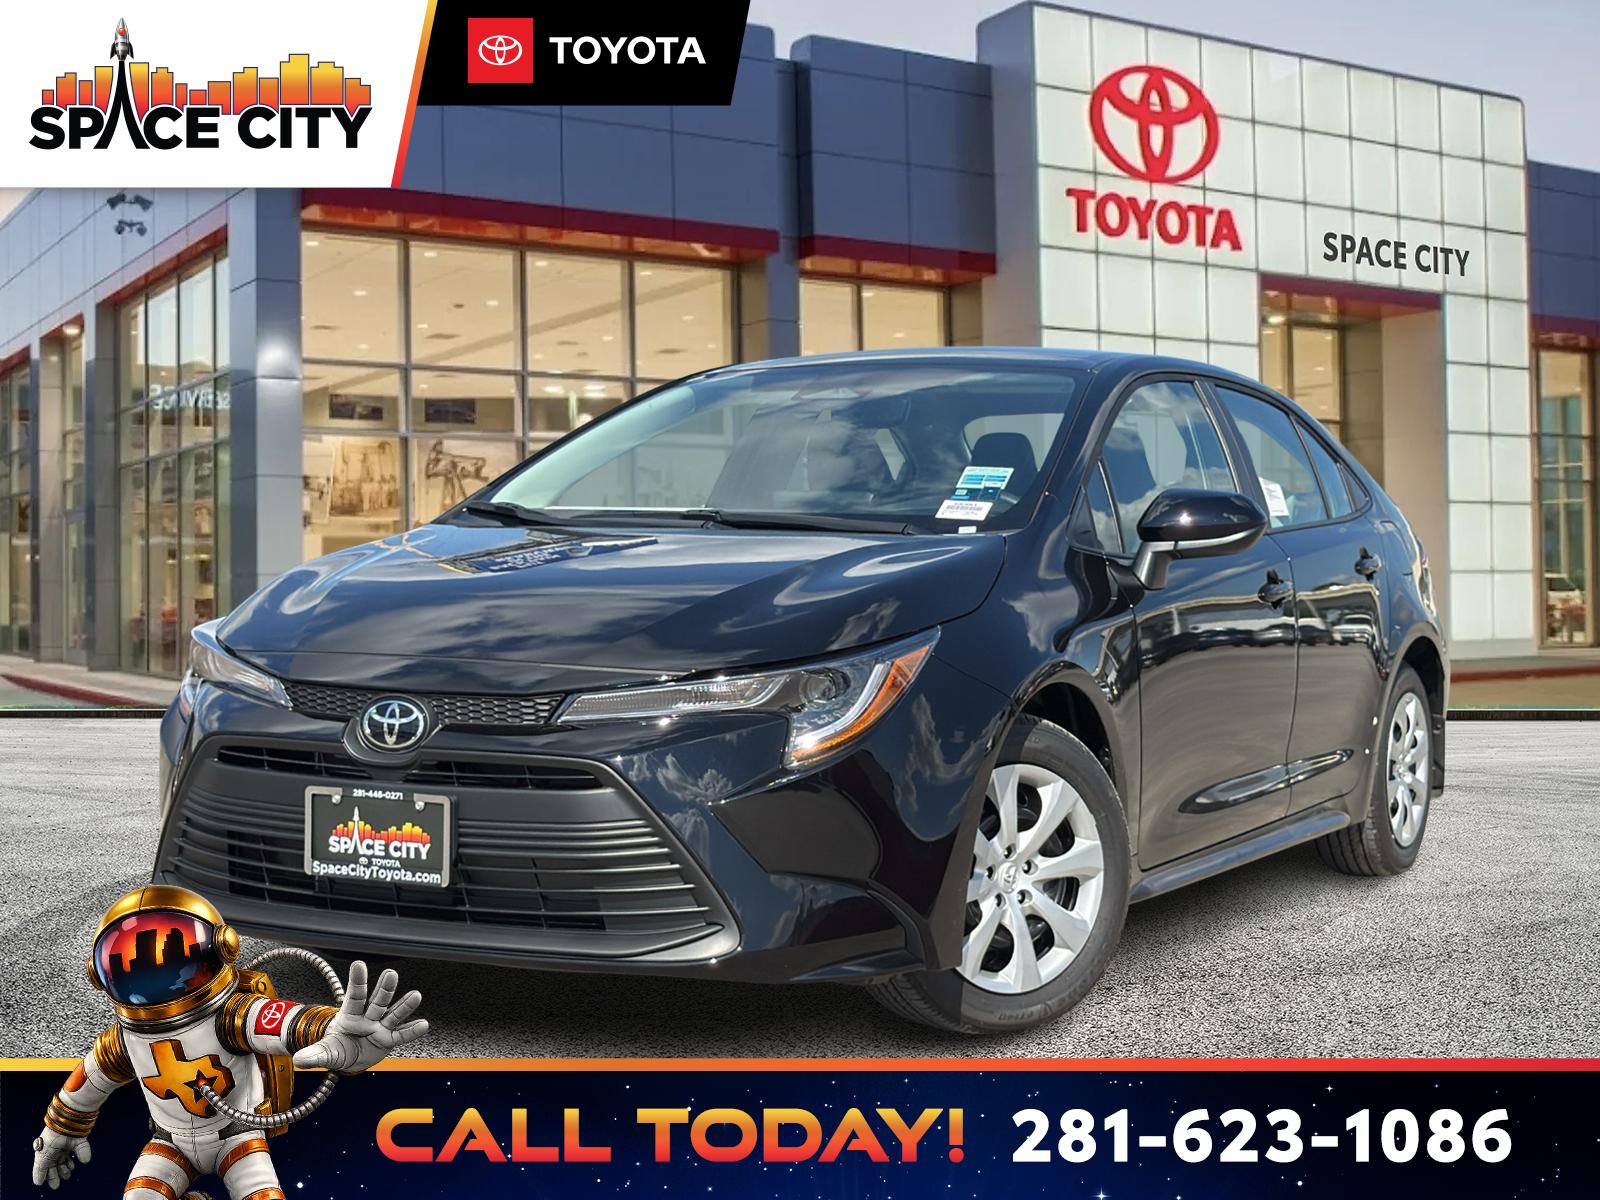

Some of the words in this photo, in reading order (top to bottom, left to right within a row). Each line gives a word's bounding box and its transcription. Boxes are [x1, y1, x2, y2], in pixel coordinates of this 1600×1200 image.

[1066, 187, 1242, 251] TOYOTA
[1322, 232, 1407, 270] SPACE
[1414, 244, 1470, 277] CITY
[328, 833, 386, 857] SPACE
[388, 840, 432, 860] CITY
[312, 860, 442, 884] SpaceCityToyota.com
[371, 858, 402, 869] TOYOTA
